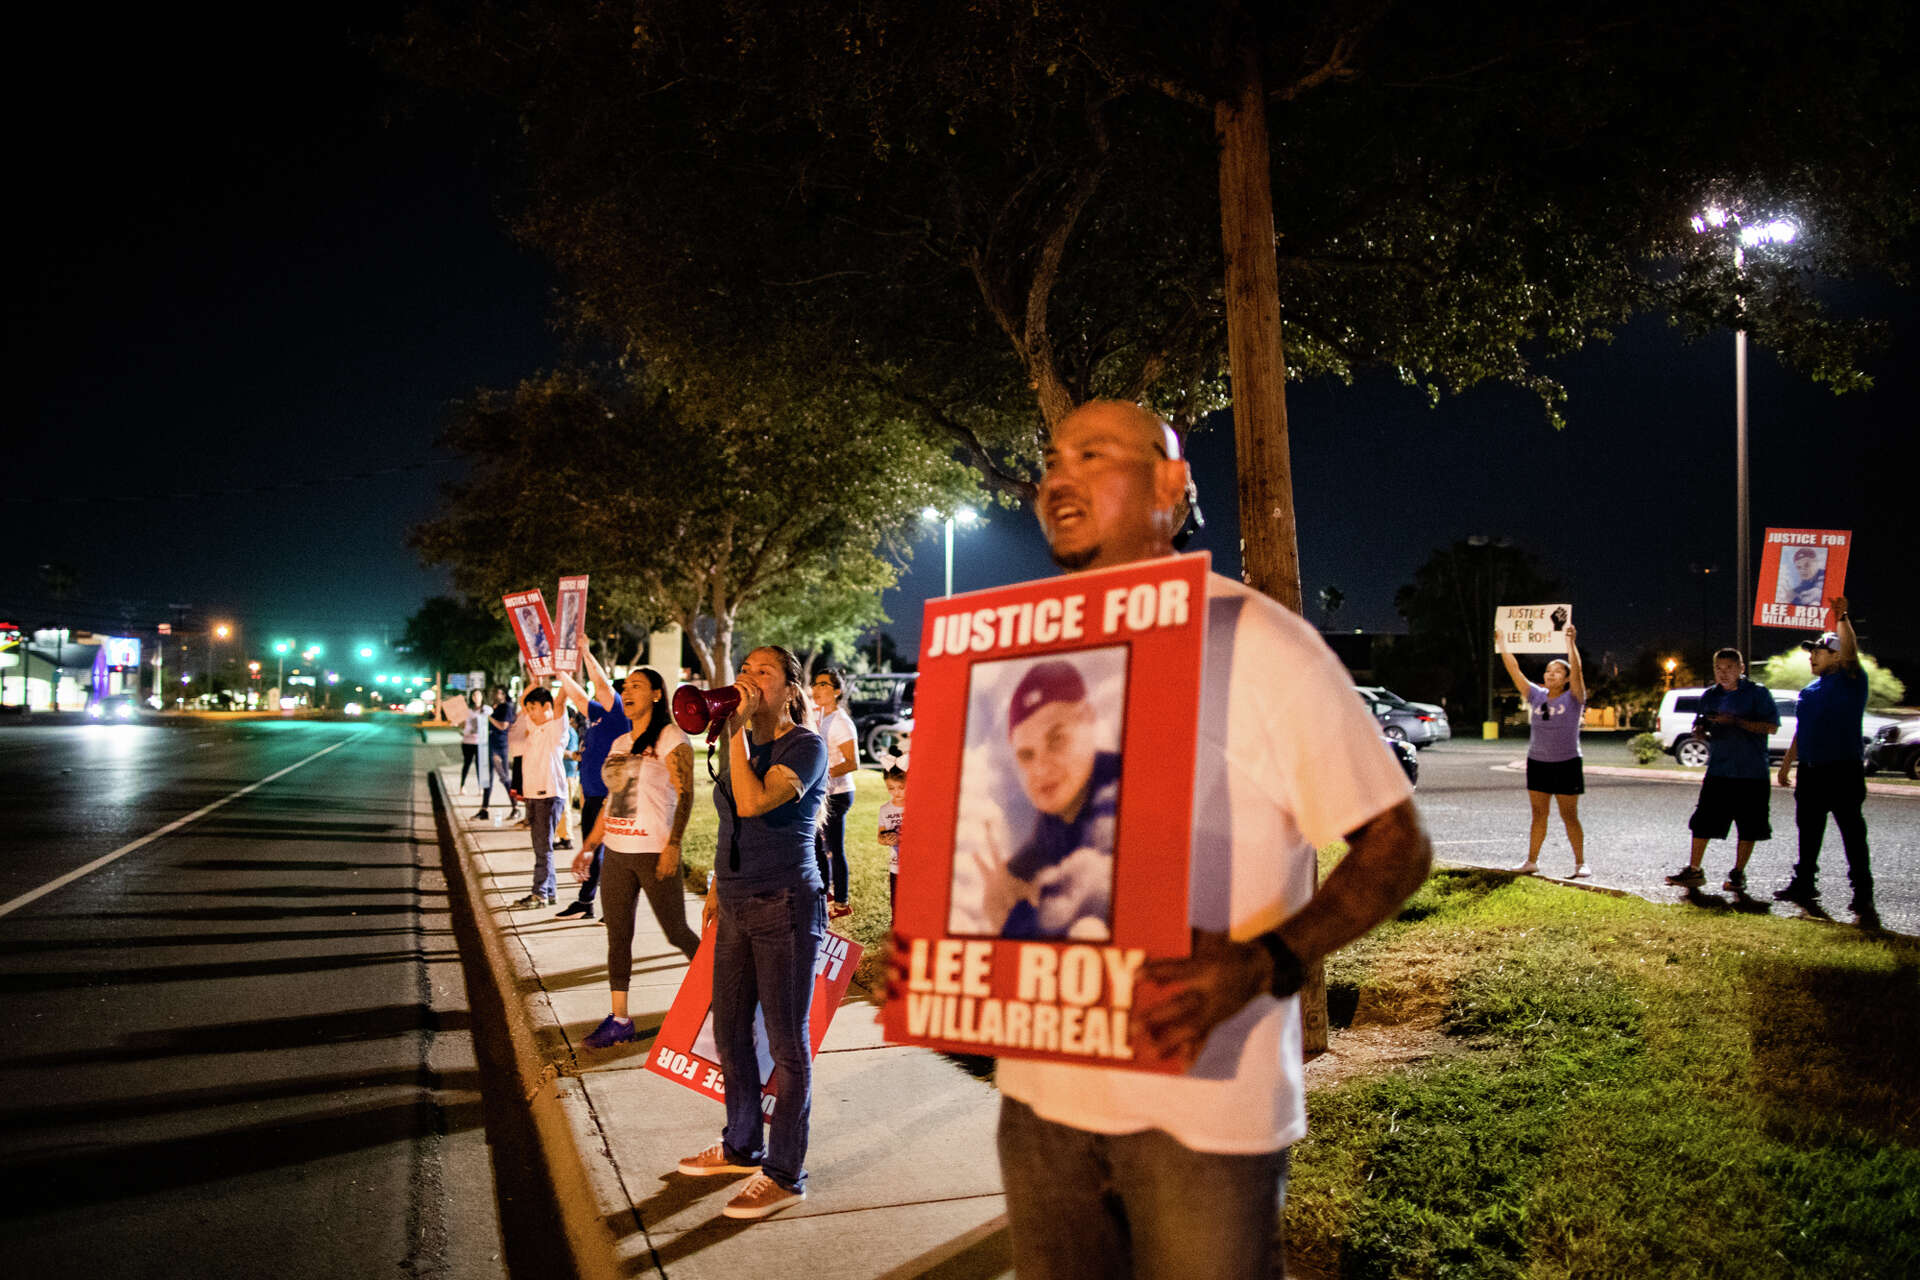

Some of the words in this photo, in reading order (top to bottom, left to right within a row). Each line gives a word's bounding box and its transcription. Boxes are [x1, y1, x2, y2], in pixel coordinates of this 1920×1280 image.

[1767, 532, 1817, 545] JUSTICE
[1821, 534, 1846, 546] FOR
[927, 594, 1085, 658] JUSTICE
[1103, 579, 1190, 634] FOR
[1507, 608, 1545, 619] JUSTICE
[1761, 603, 1788, 616] LEE
[1794, 605, 1830, 619] ROY
[1515, 620, 1534, 631] FOR
[1761, 614, 1826, 628] VILLARREAL
[1507, 632, 1523, 643] LEE
[908, 939, 992, 998] LEE
[1017, 945, 1146, 1010] ROY
[908, 994, 1134, 1059] VILLARREAL
[656, 1047, 700, 1081] FOR
